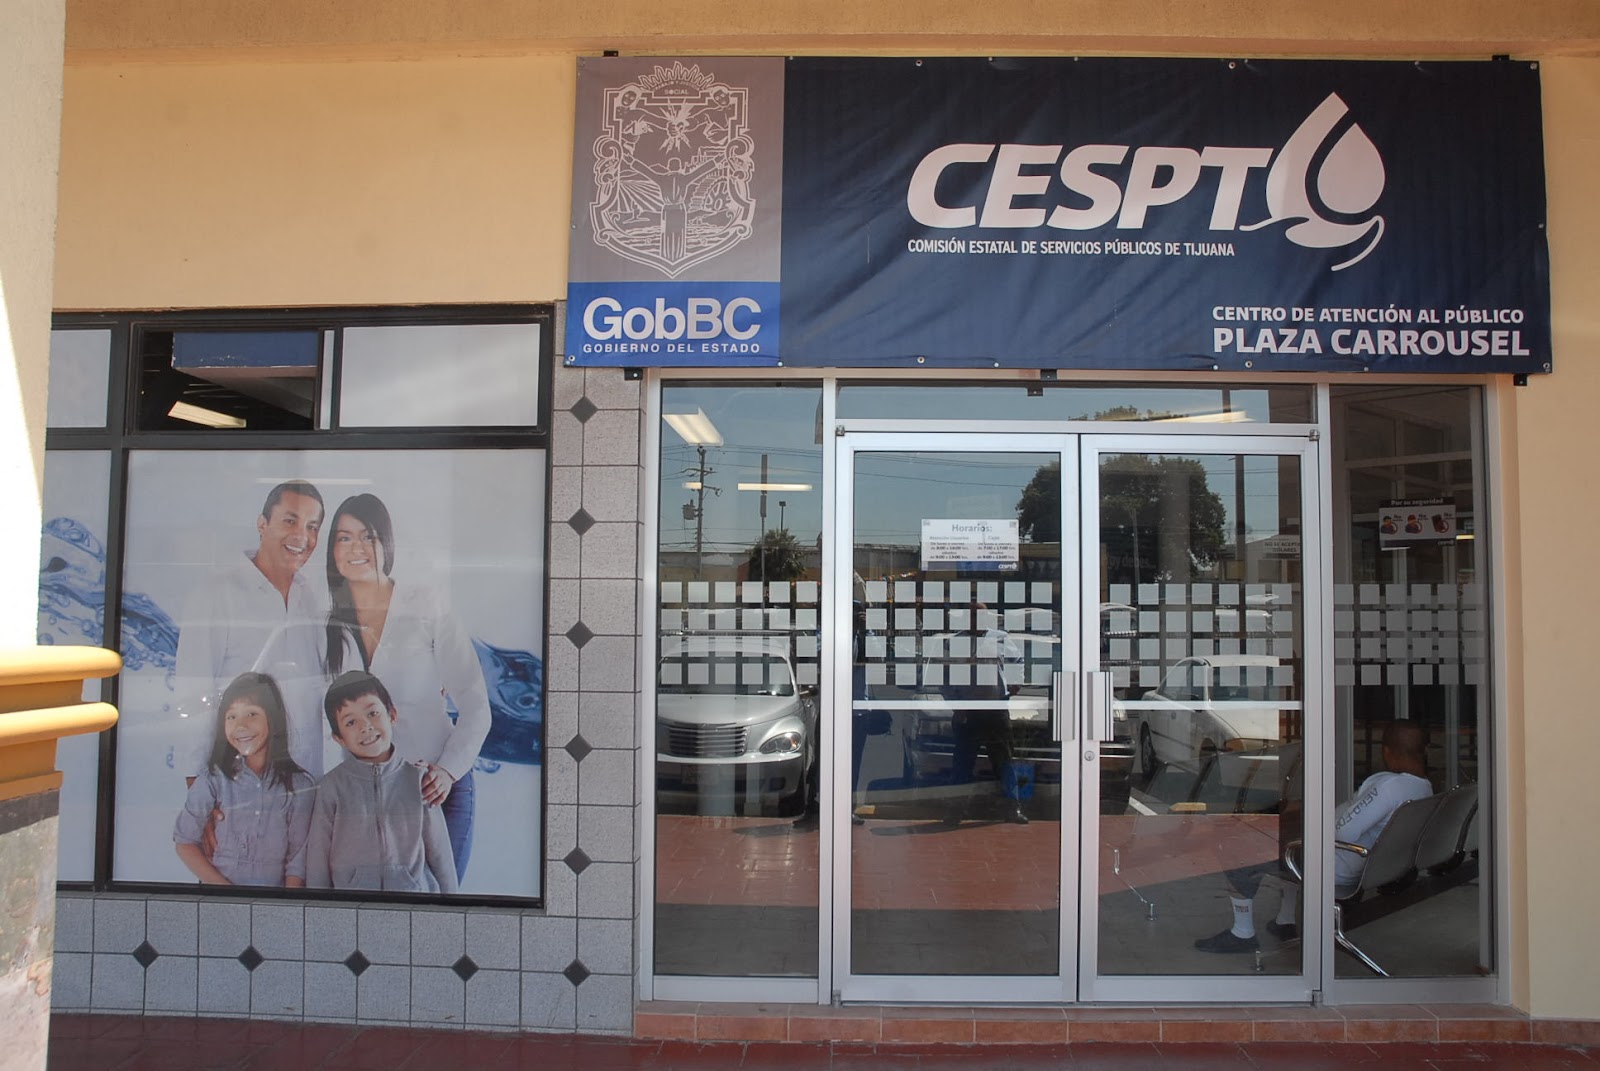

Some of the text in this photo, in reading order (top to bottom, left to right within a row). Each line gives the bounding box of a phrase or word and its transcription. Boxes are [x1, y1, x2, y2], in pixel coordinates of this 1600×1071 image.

[907, 143, 1274, 231] CESPT
[907, 237, 1235, 257] COMISIÓN ESTATAL DE SERVICIOS PÚBLICOS DE TIJUANA
[583, 297, 762, 340] GobBC
[1212, 304, 1524, 324] CENTRO DE ATENCIÓN AL PÚBLICO
[583, 343, 760, 353] GOBIERNO DEL ESTADO
[1213, 327, 1530, 356] PLAZA CARROUSEL
[1412, 498, 1444, 506] seguridad
[952, 523, 992, 532] Horarios:
